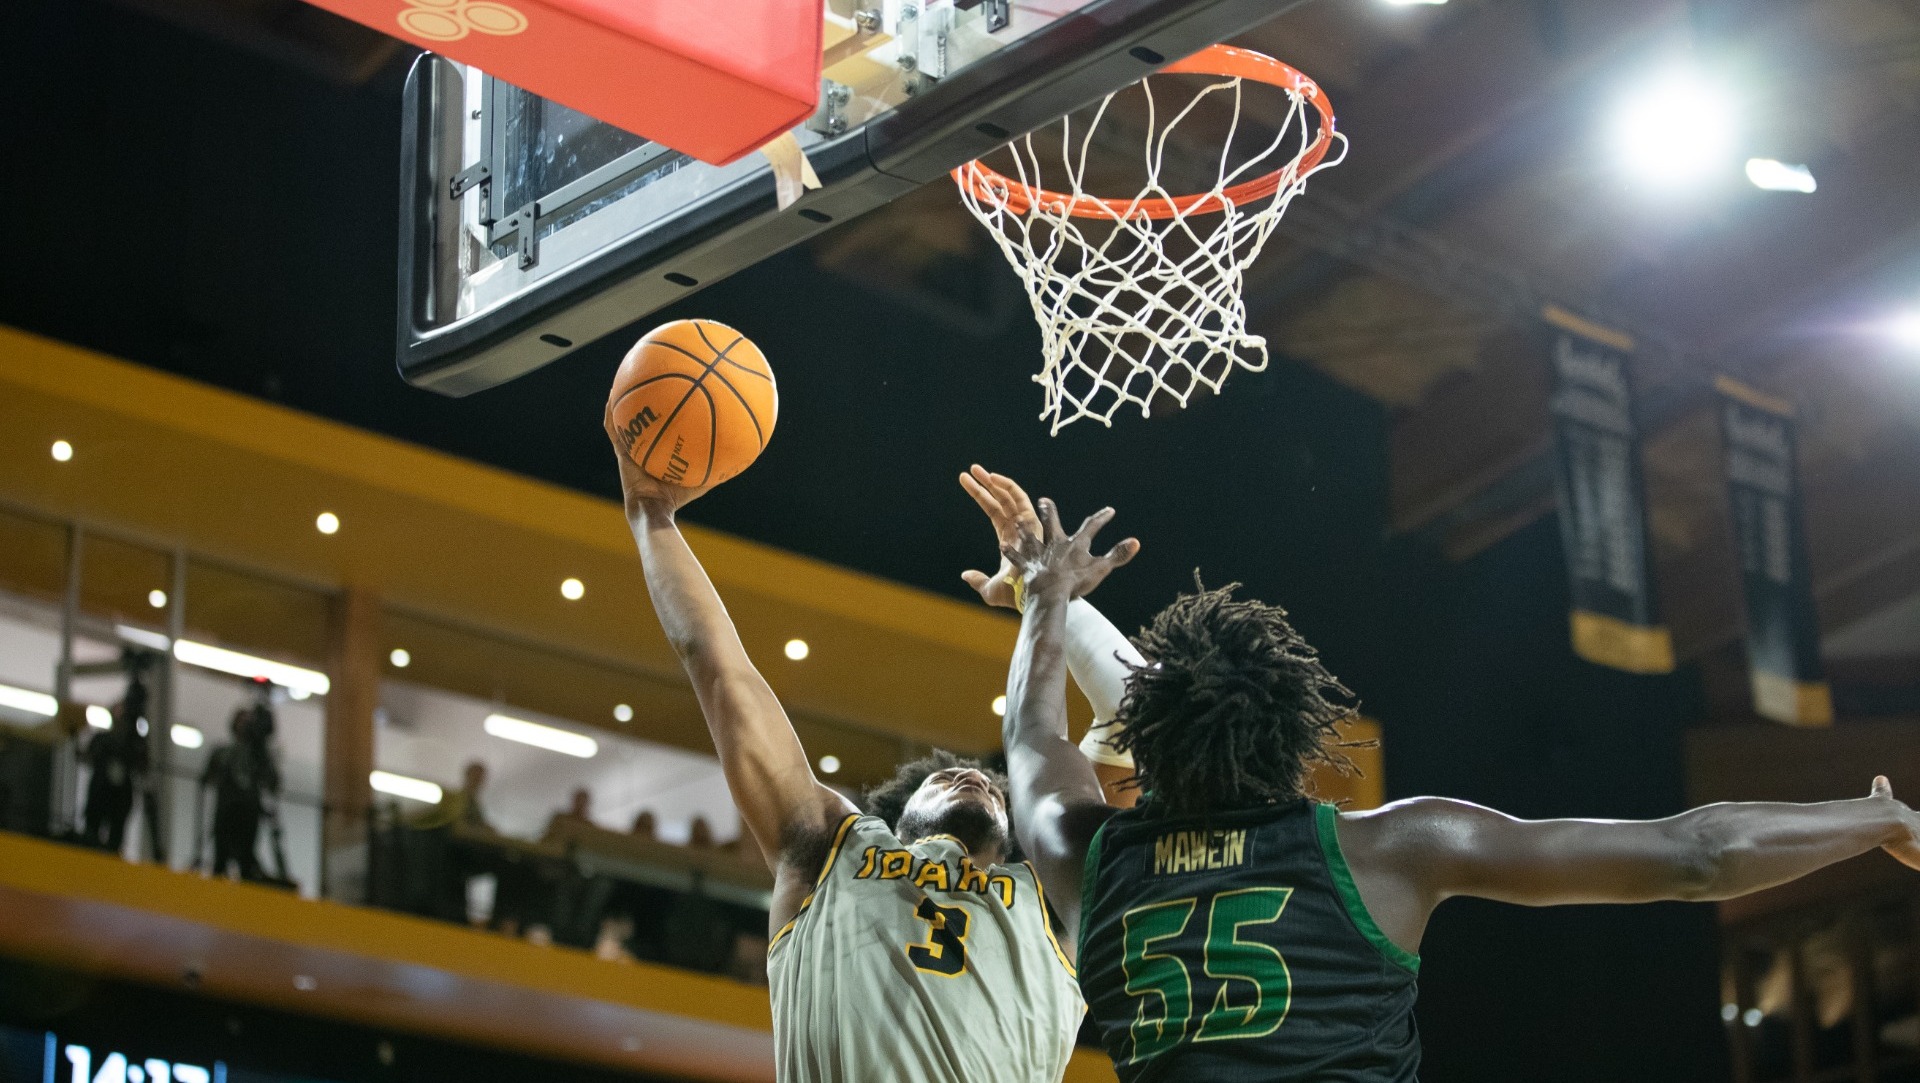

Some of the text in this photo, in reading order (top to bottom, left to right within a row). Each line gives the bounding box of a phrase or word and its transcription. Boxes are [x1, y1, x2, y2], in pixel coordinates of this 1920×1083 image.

[1154, 828, 1247, 875] MAWEIN
[905, 897, 972, 979] 3
[1122, 886, 1294, 1066] 55
